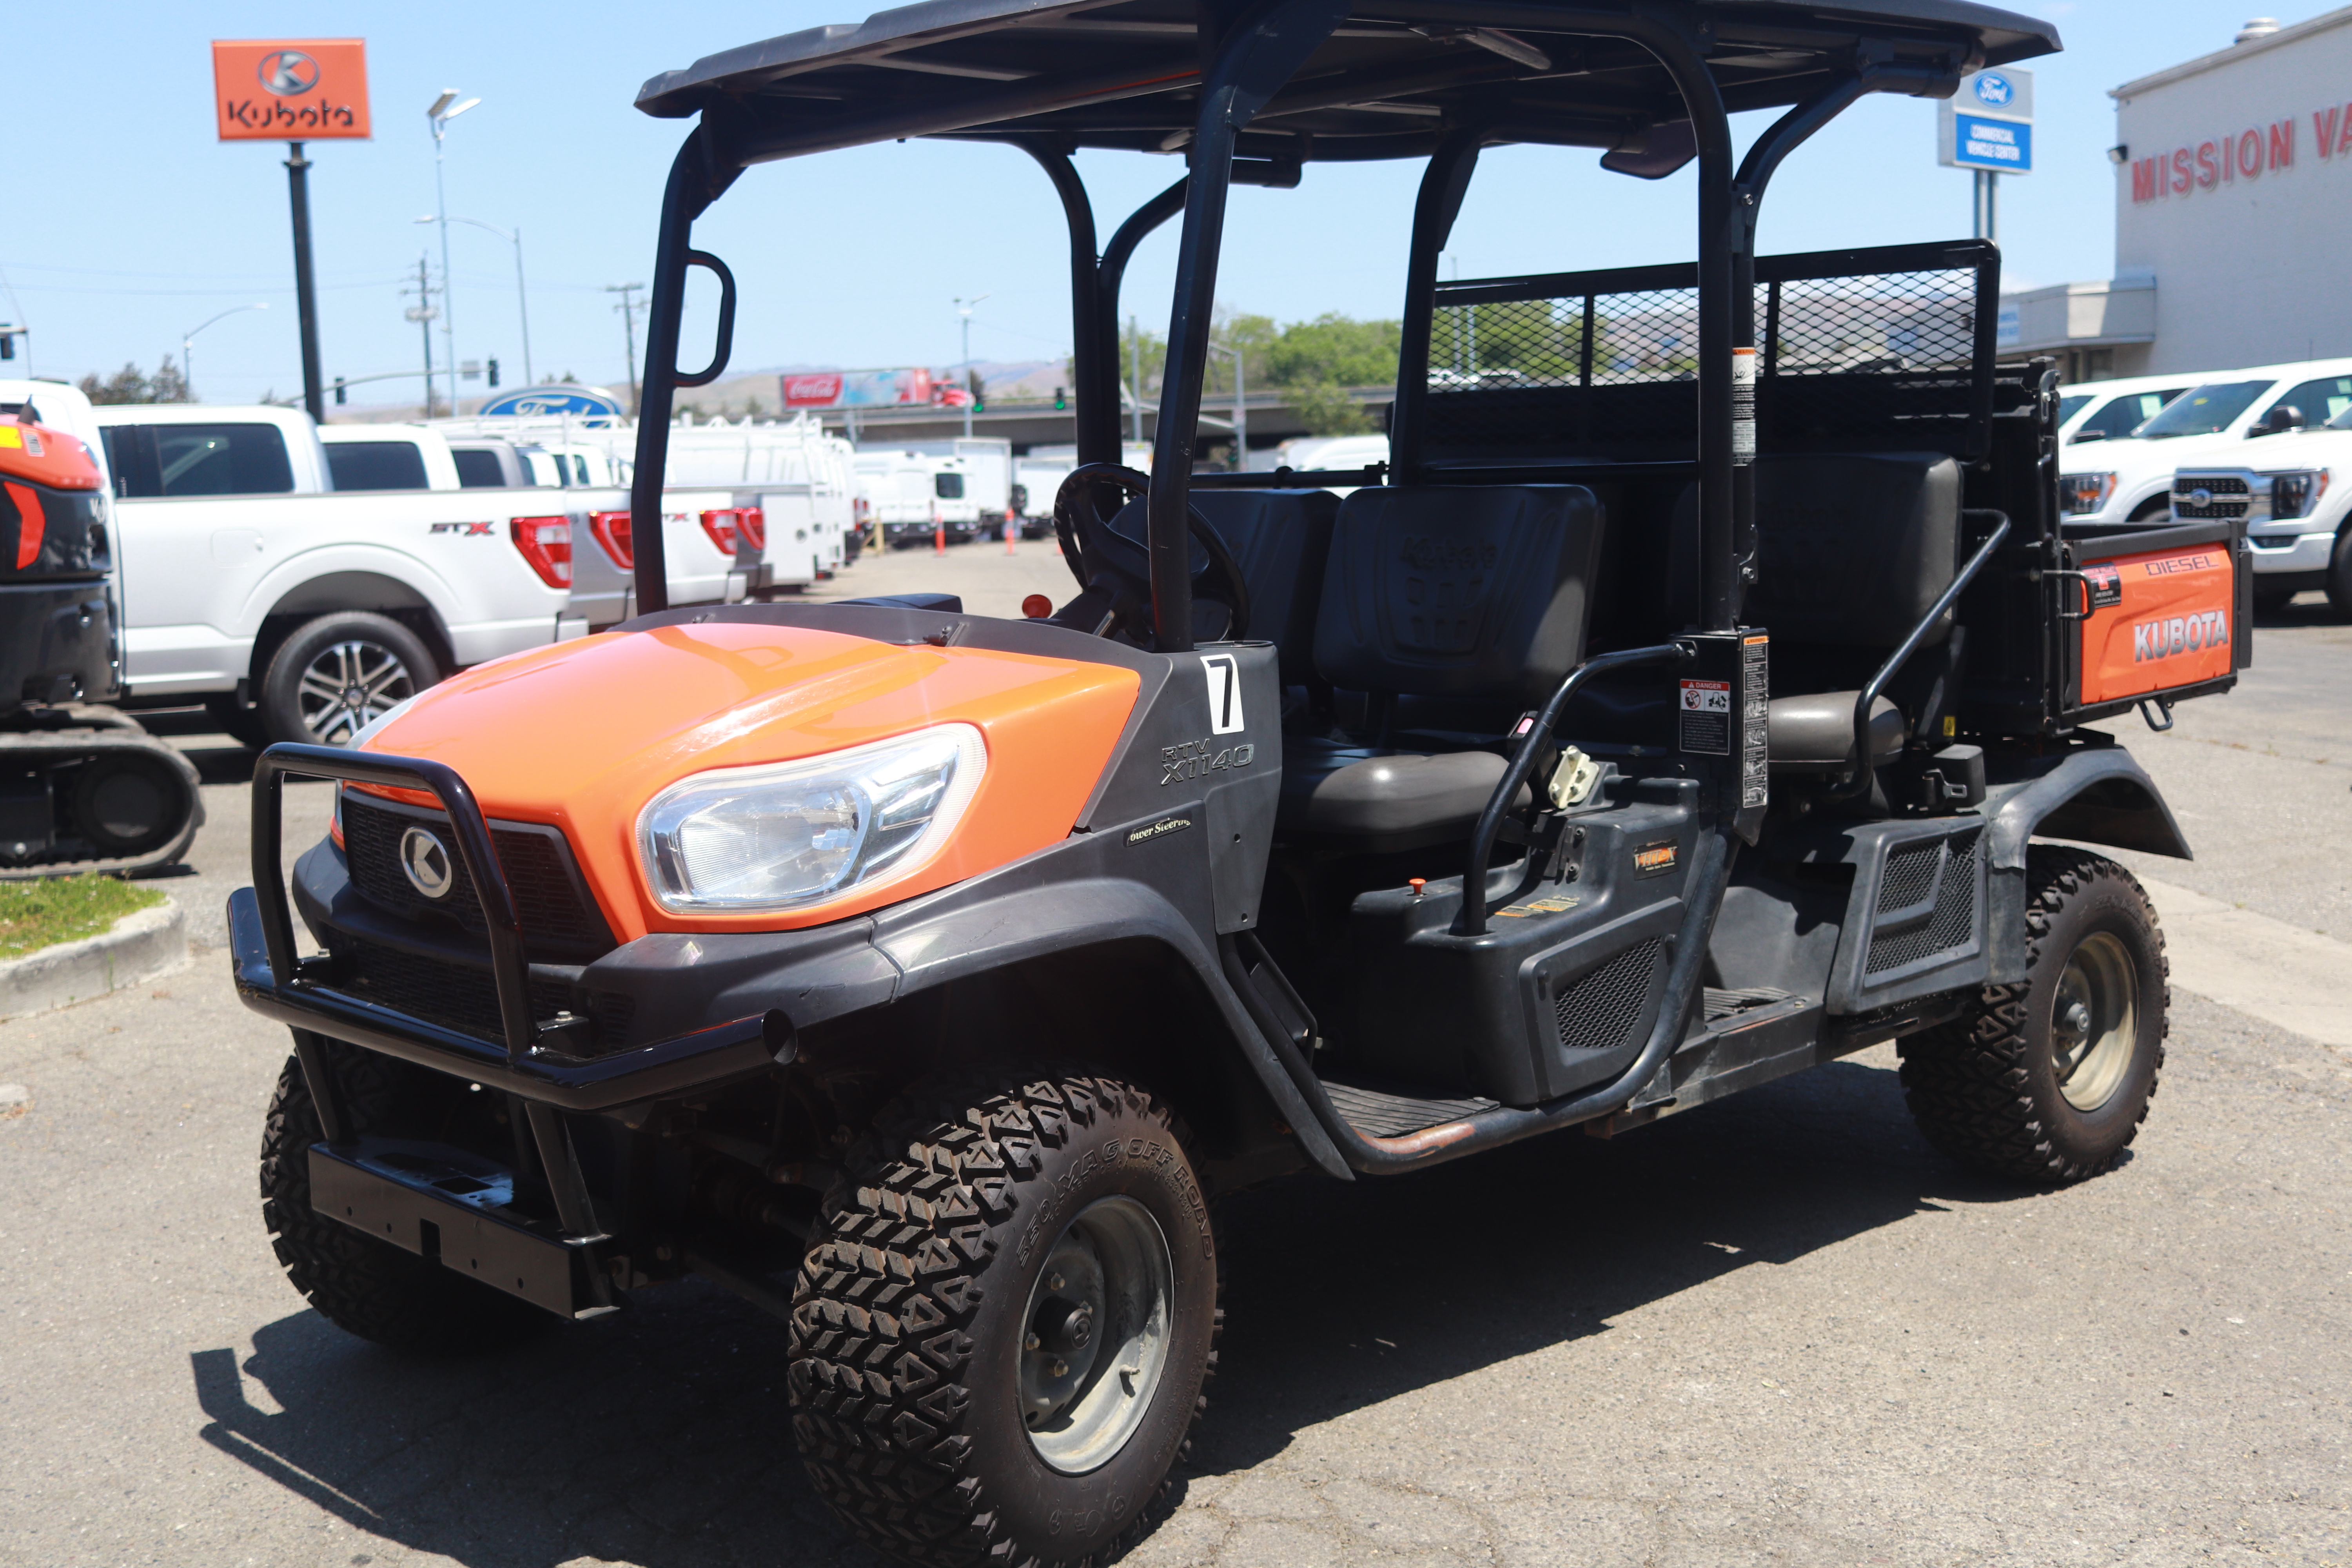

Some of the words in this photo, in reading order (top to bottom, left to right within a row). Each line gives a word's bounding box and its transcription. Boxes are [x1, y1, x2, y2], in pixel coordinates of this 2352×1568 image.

[1979, 76, 2007, 103] Ford
[228, 98, 353, 127] Kubota
[2132, 119, 2294, 205] MISSION
[429, 521, 494, 535] STX
[2145, 555, 2220, 576] DIESEL
[2135, 610, 2228, 662] KUBOTA
[1161, 738, 1210, 762] RTV
[1161, 744, 1254, 785] X1140
[1130, 827, 1154, 842] ower
[1058, 1138, 1120, 1190] MAG
[1127, 1138, 1174, 1165] OFF
[1174, 1164, 1213, 1258] ROAD
